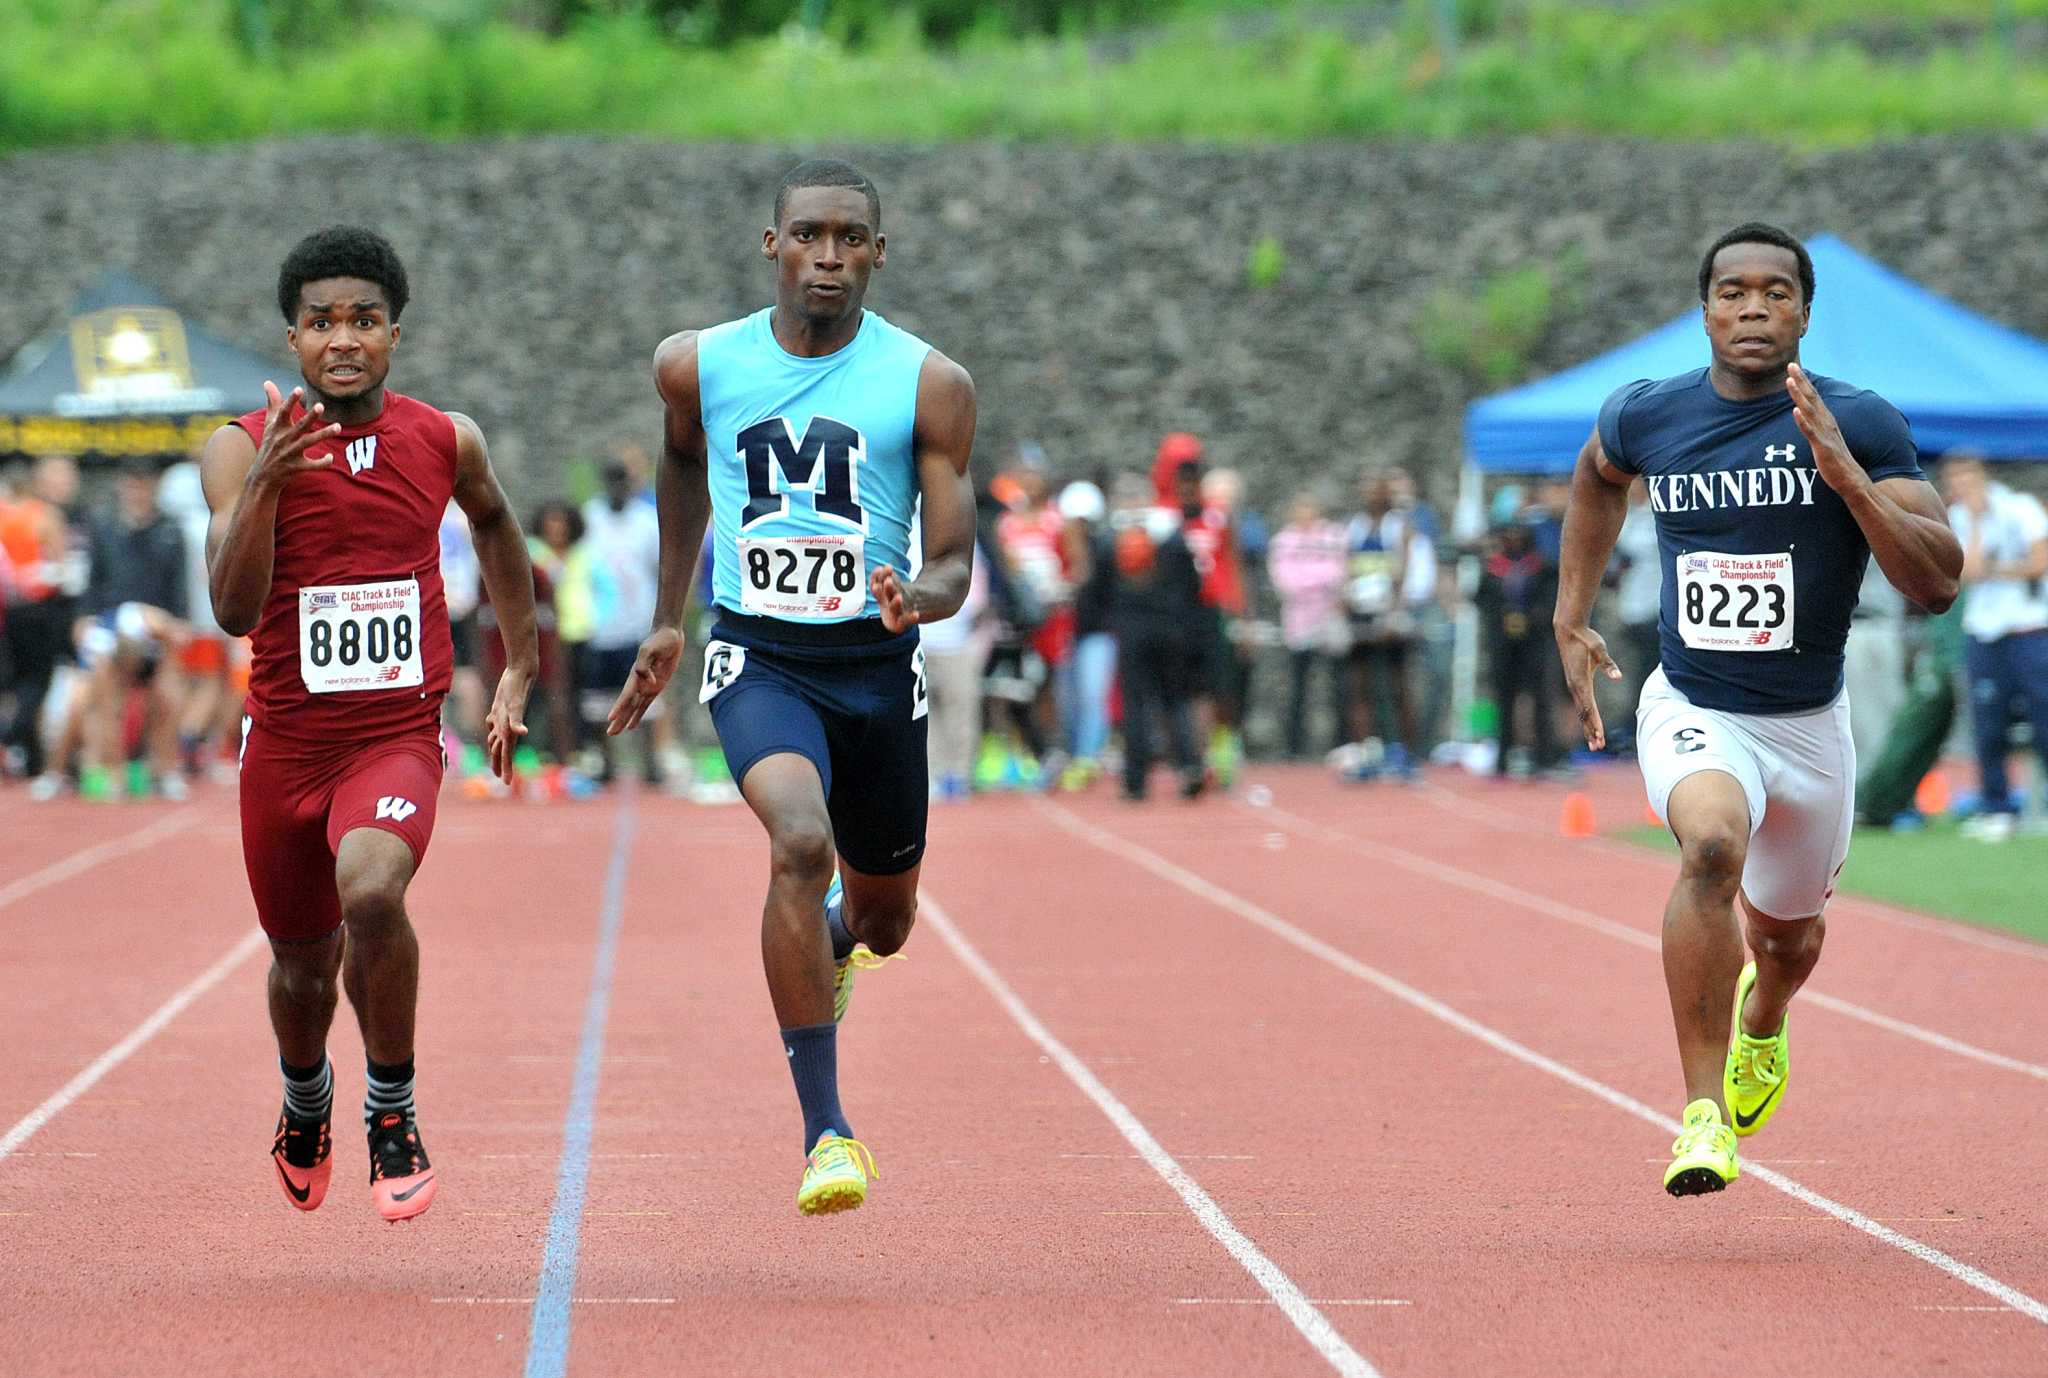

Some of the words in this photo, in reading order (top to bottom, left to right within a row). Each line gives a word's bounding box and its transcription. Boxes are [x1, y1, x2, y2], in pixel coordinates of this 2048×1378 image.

[345, 434, 377, 476] W
[736, 416, 868, 535] M
[1648, 467, 1818, 512] KENNEDY
[747, 547, 856, 594] 8278
[1712, 559, 1730, 569] CIAC
[1732, 560, 1754, 570] Track
[1756, 560, 1762, 569] &
[1764, 559, 1784, 569] Field
[1720, 570, 1776, 581] Championship
[341, 591, 361, 602] CIAC
[363, 589, 384, 600] Track
[385, 588, 391, 598] &
[393, 587, 411, 597] Field
[351, 600, 405, 613] Championship
[778, 603, 809, 611] balance
[1685, 581, 1786, 629] 8223
[309, 614, 413, 667] 8808
[1711, 637, 1740, 645] balance
[340, 676, 371, 685] balance
[375, 796, 417, 822] W
